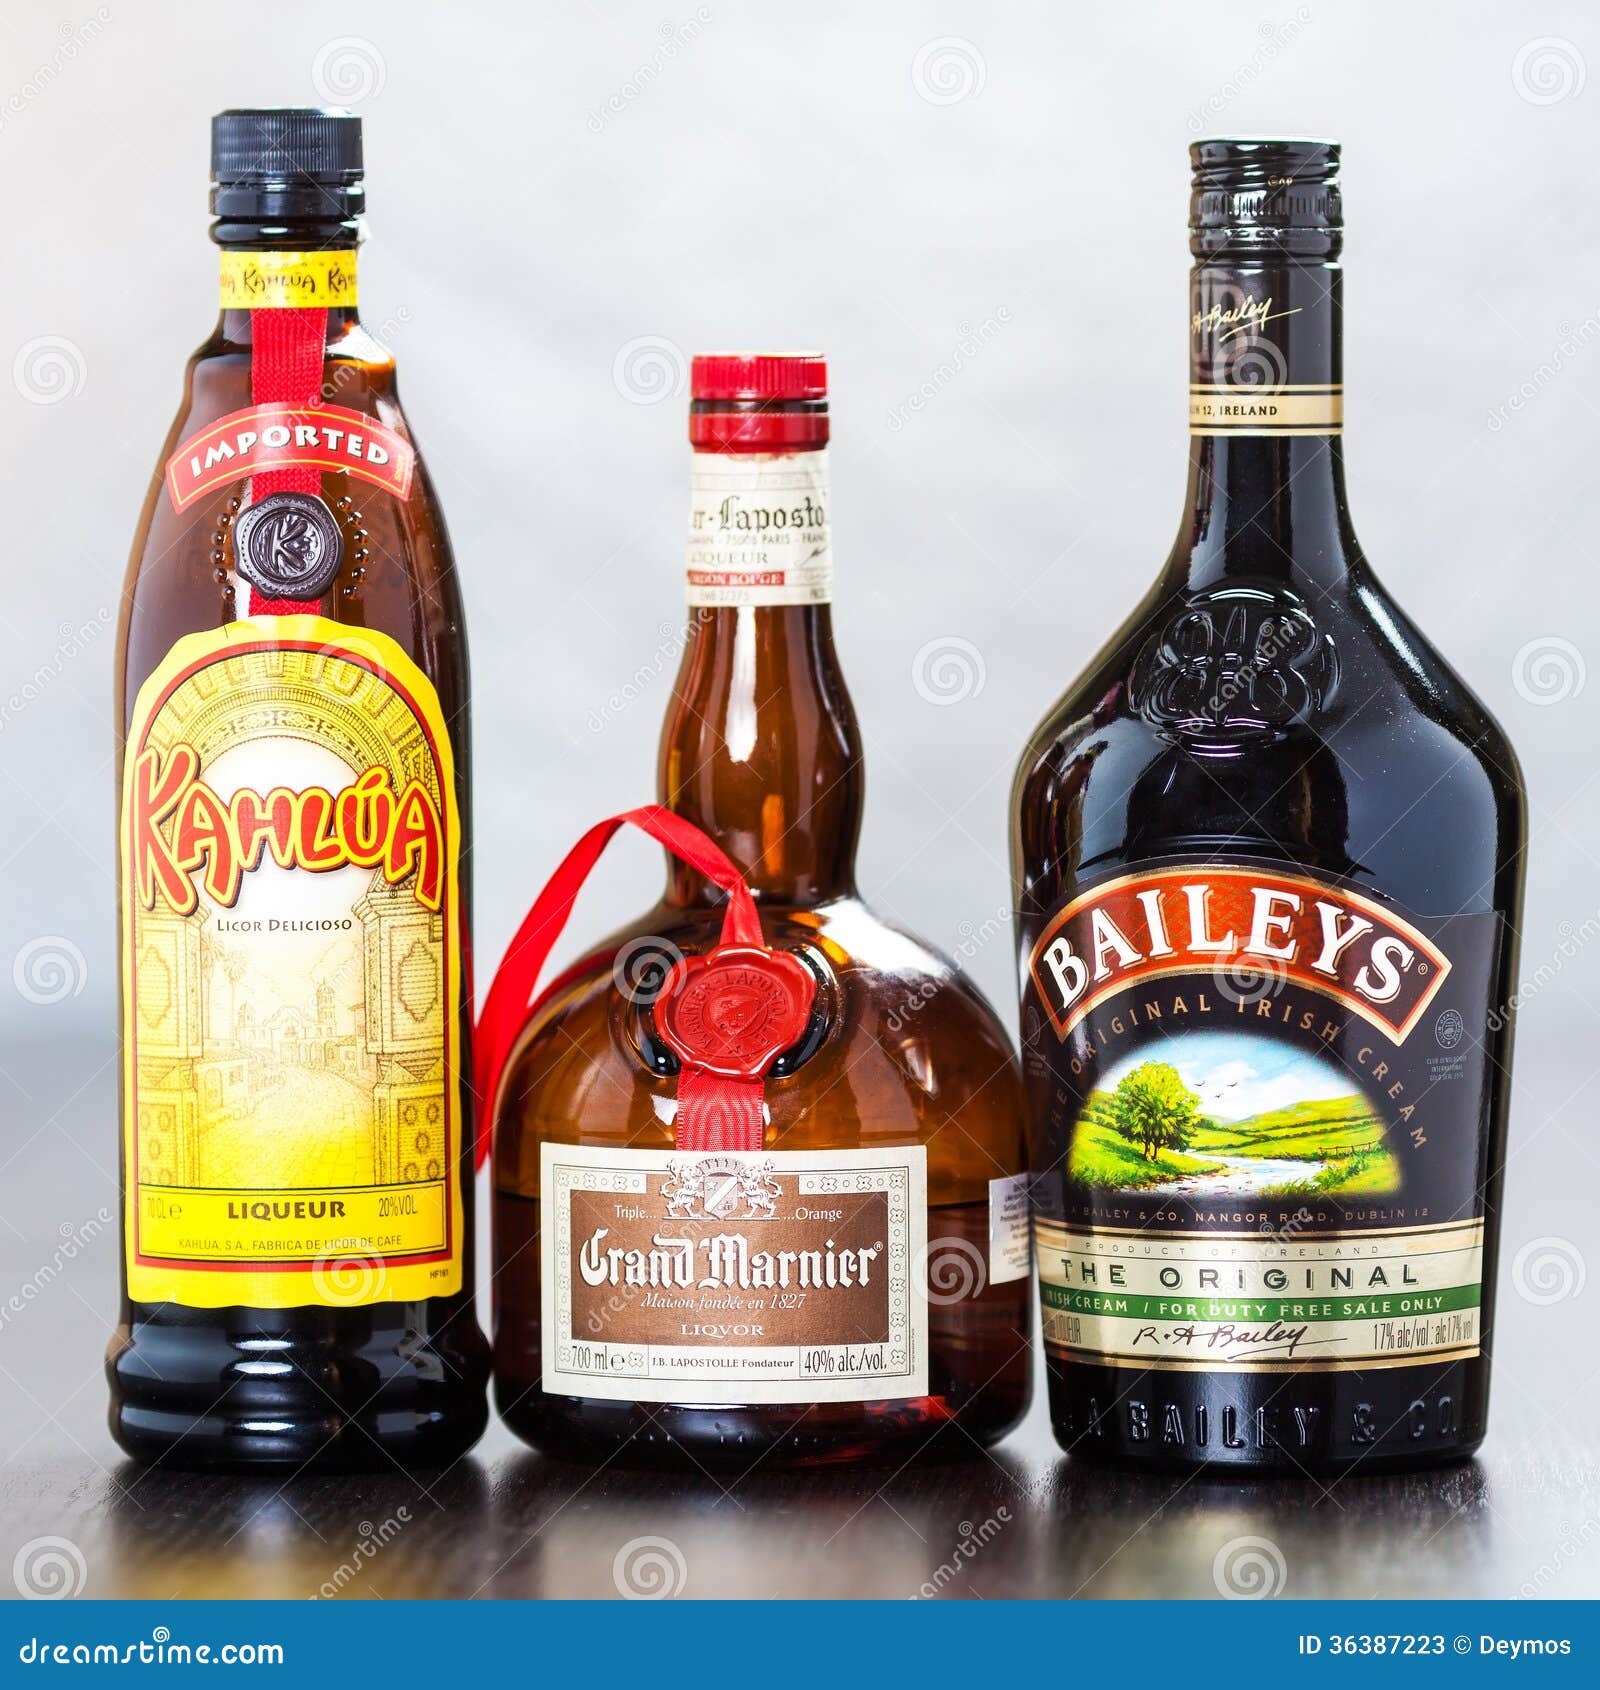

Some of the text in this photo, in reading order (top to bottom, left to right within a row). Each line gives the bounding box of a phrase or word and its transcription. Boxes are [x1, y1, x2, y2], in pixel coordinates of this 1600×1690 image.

[1219, 404, 1278, 417] IRELAND
[190, 425, 392, 479] IMPORTED
[134, 742, 446, 917] KAHLÚA
[1043, 884, 1416, 1009] BAILEYS
[1070, 994, 1211, 1075] ORIGINAL
[1237, 995, 1341, 1043] IRISH
[1356, 1047, 1428, 1149] CREAM
[228, 1201, 346, 1221] LIQUEUR
[1083, 1206, 1130, 1219] BAILEY
[1138, 1211, 1147, 1220] &
[1195, 1212, 1269, 1223] NANGOR
[1345, 1208, 1406, 1221] DUBLIN
[1414, 1207, 1429, 1217] 12
[252, 1239, 302, 1251] FABRICA
[306, 1239, 321, 1250] DE
[324, 1237, 357, 1250] LICOR
[360, 1236, 374, 1248] DE
[1085, 1241, 1379, 1258] PRODUCT OF IRELAND
[579, 1228, 879, 1291] Grand Marnier
[1060, 1258, 1421, 1292] THE ORIGINAL
[641, 1292, 695, 1310] Maison
[744, 1298, 765, 1310] en
[770, 1293, 807, 1310] 1827
[1075, 1295, 1128, 1312] CREAM
[1159, 1303, 1198, 1316] FOR
[1209, 1303, 1267, 1317] DUTY
[1279, 1303, 1332, 1317] FREE
[1343, 1300, 1392, 1316] SALE
[1400, 1296, 1444, 1312] ONLY
[680, 1323, 765, 1339] LIQVOR
[1373, 1321, 1395, 1351] 17%
[572, 1345, 591, 1369] 700
[594, 1345, 609, 1371] ml
[652, 1357, 669, 1367] J.B.
[670, 1357, 739, 1369] LAPOSTOLLE
[741, 1358, 795, 1368] Fondateur
[803, 1350, 835, 1374] 40%
[838, 1344, 888, 1373] alc./vol.
[1127, 1400, 1320, 1449] BAILEY
